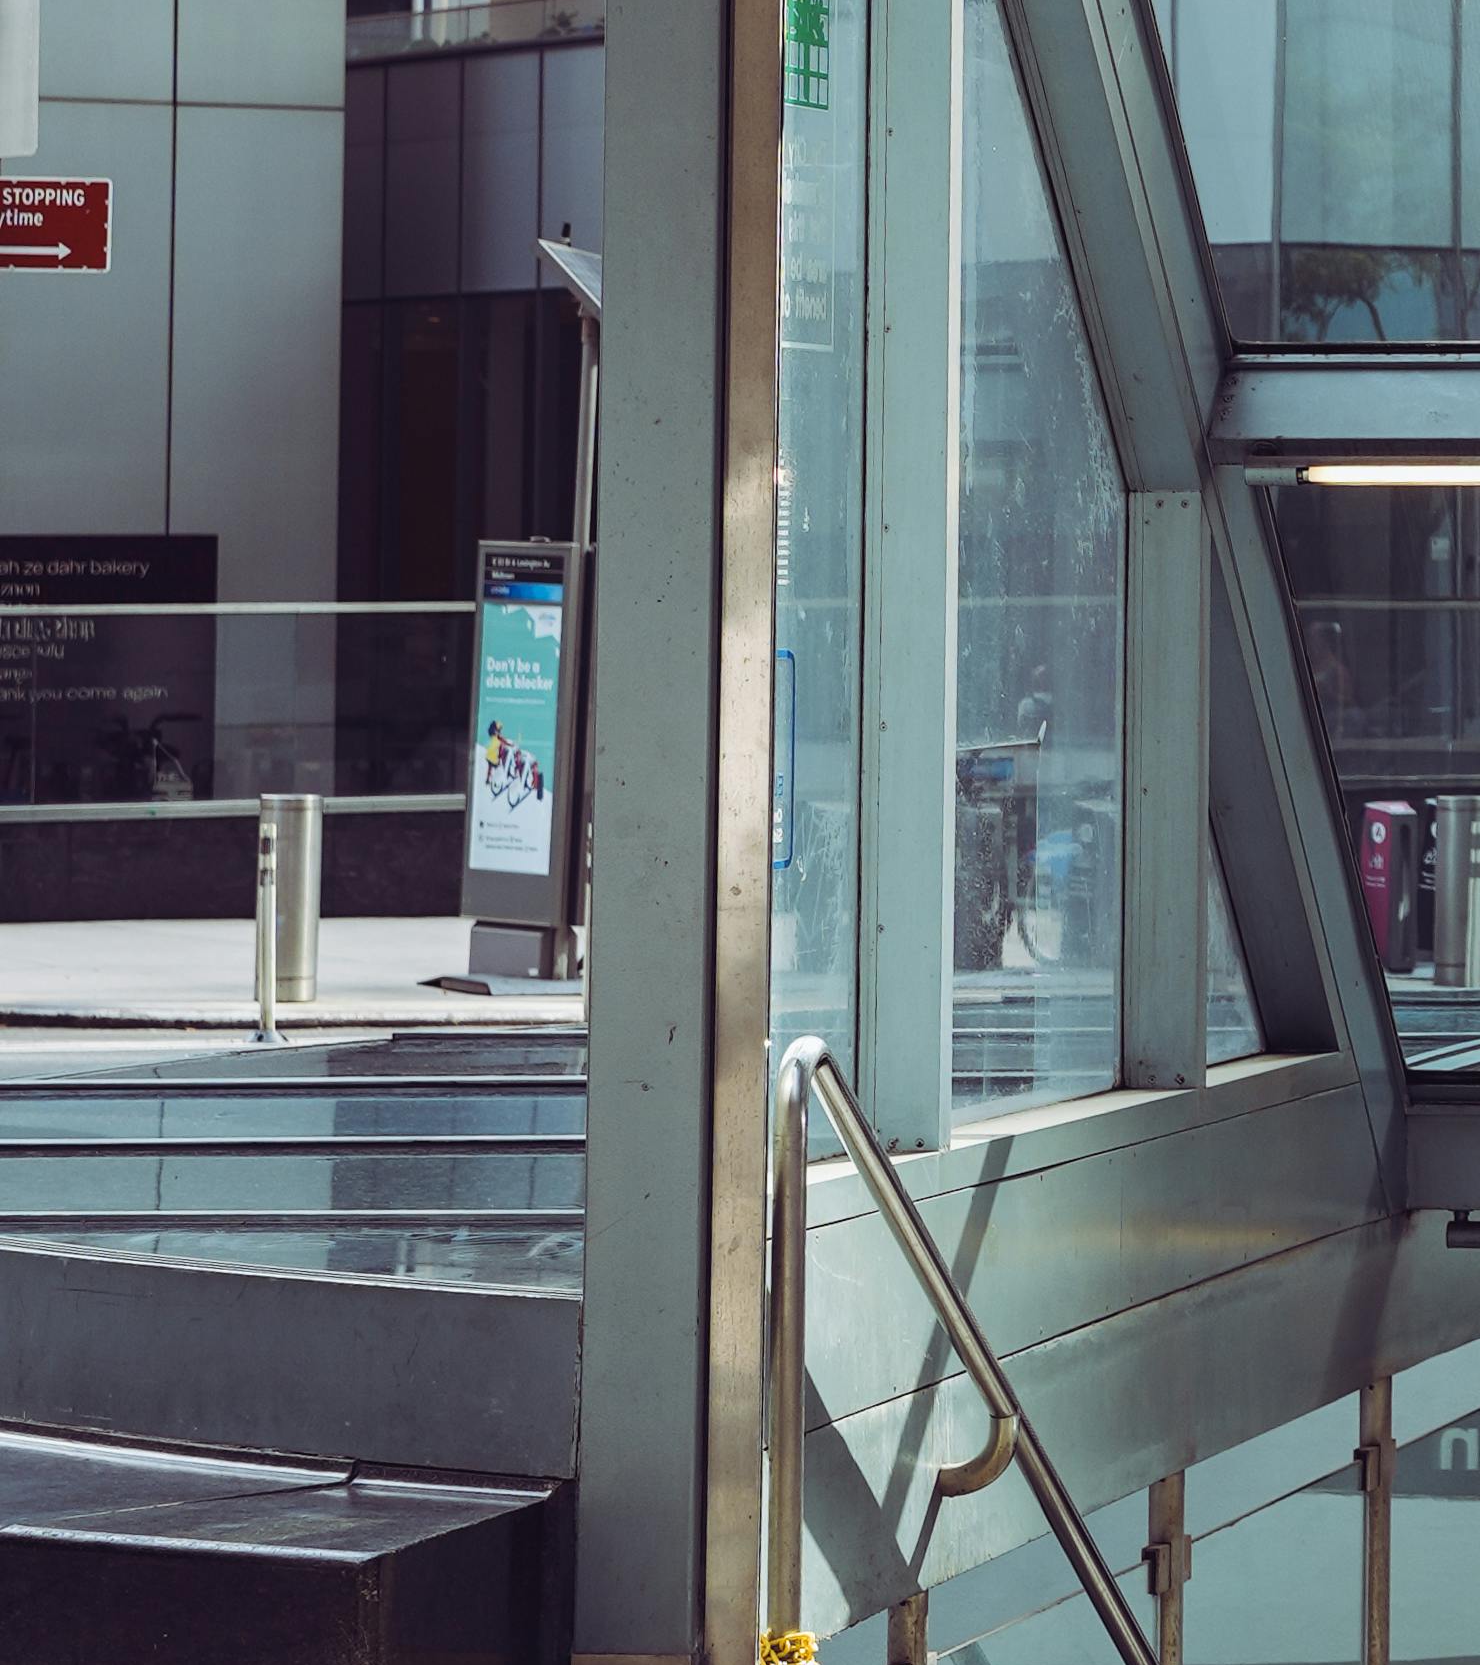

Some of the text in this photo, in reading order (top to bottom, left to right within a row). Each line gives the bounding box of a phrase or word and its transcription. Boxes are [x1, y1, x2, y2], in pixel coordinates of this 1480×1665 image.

[2, 187, 86, 207] STOPPING
[90, 557, 151, 579] bakery
[487, 656, 515, 672] Don't
[516, 657, 531, 673] be
[513, 673, 554, 690] blocker
